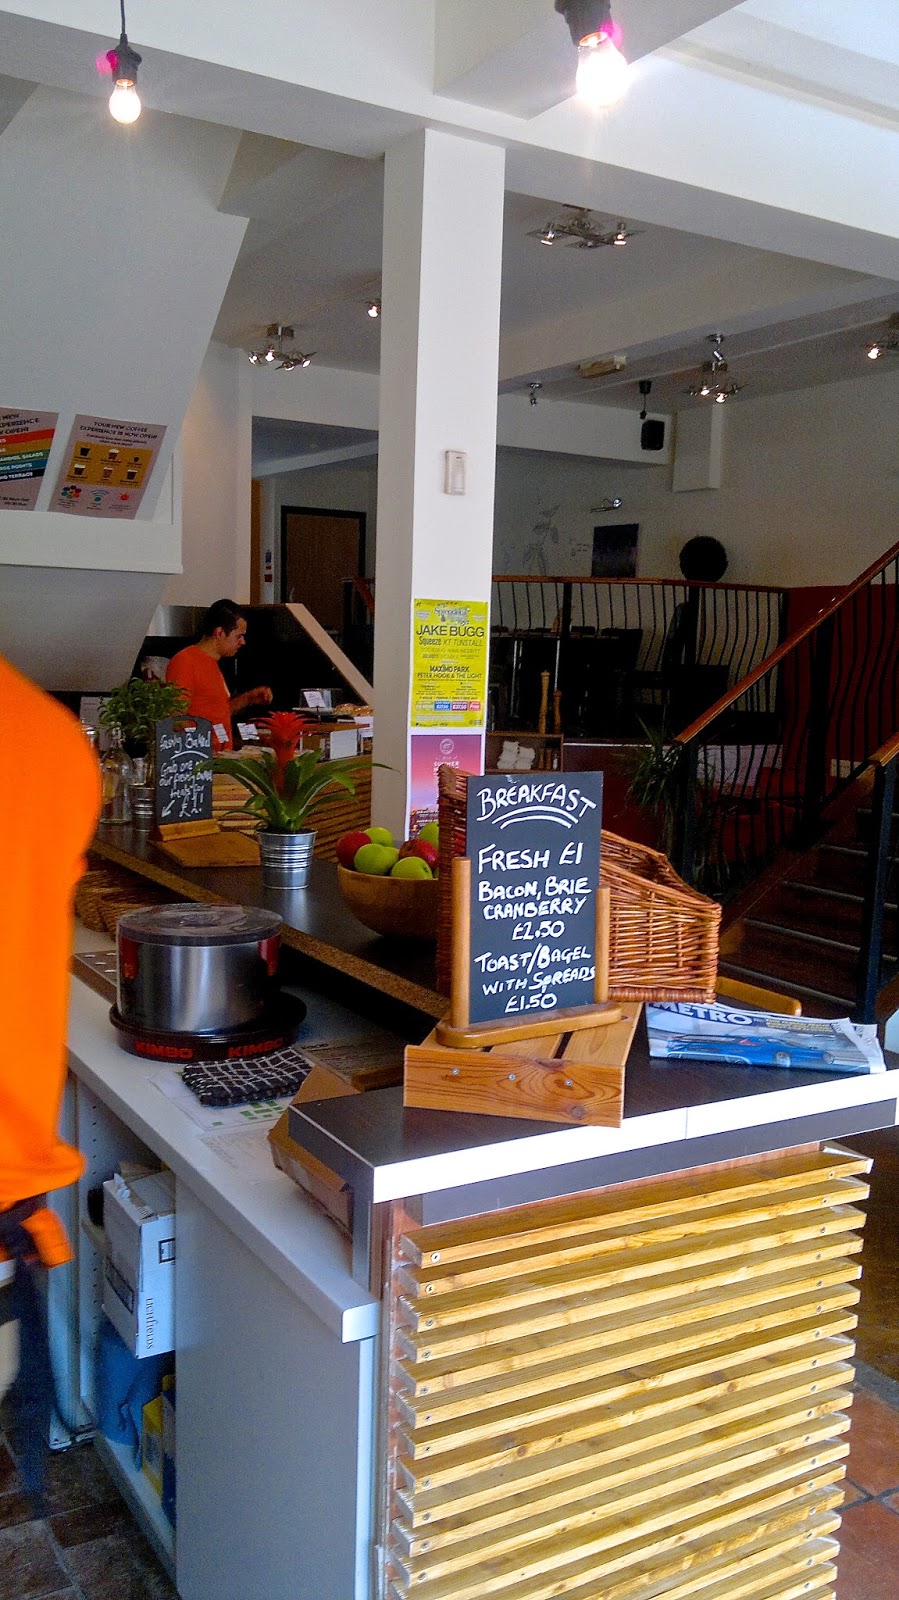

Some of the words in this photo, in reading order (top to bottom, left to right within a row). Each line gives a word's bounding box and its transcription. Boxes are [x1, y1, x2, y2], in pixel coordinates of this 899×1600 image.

[80, 425, 116, 435] EXPERIENCE
[93, 421, 111, 429] YOUR
[416, 625, 447, 636] JAKE
[449, 626, 485, 638] BUGG
[419, 636, 442, 646] Squeeze
[453, 639, 483, 647] TUNSTALL
[476, 782, 598, 822] BREAKFAST
[478, 843, 551, 875] FRESH
[478, 880, 542, 902] BACON,
[545, 876, 592, 896] BRIE
[483, 896, 587, 920] CRANBERRY
[512, 920, 565, 941] £2.50
[482, 977, 528, 996] WITH
[528, 965, 596, 994] SPREADS
[504, 992, 558, 1013] £1.50
[653, 1002, 753, 1026] METRO
[134, 1040, 194, 1059] KIMBO
[227, 1037, 284, 1058] KIMBO
